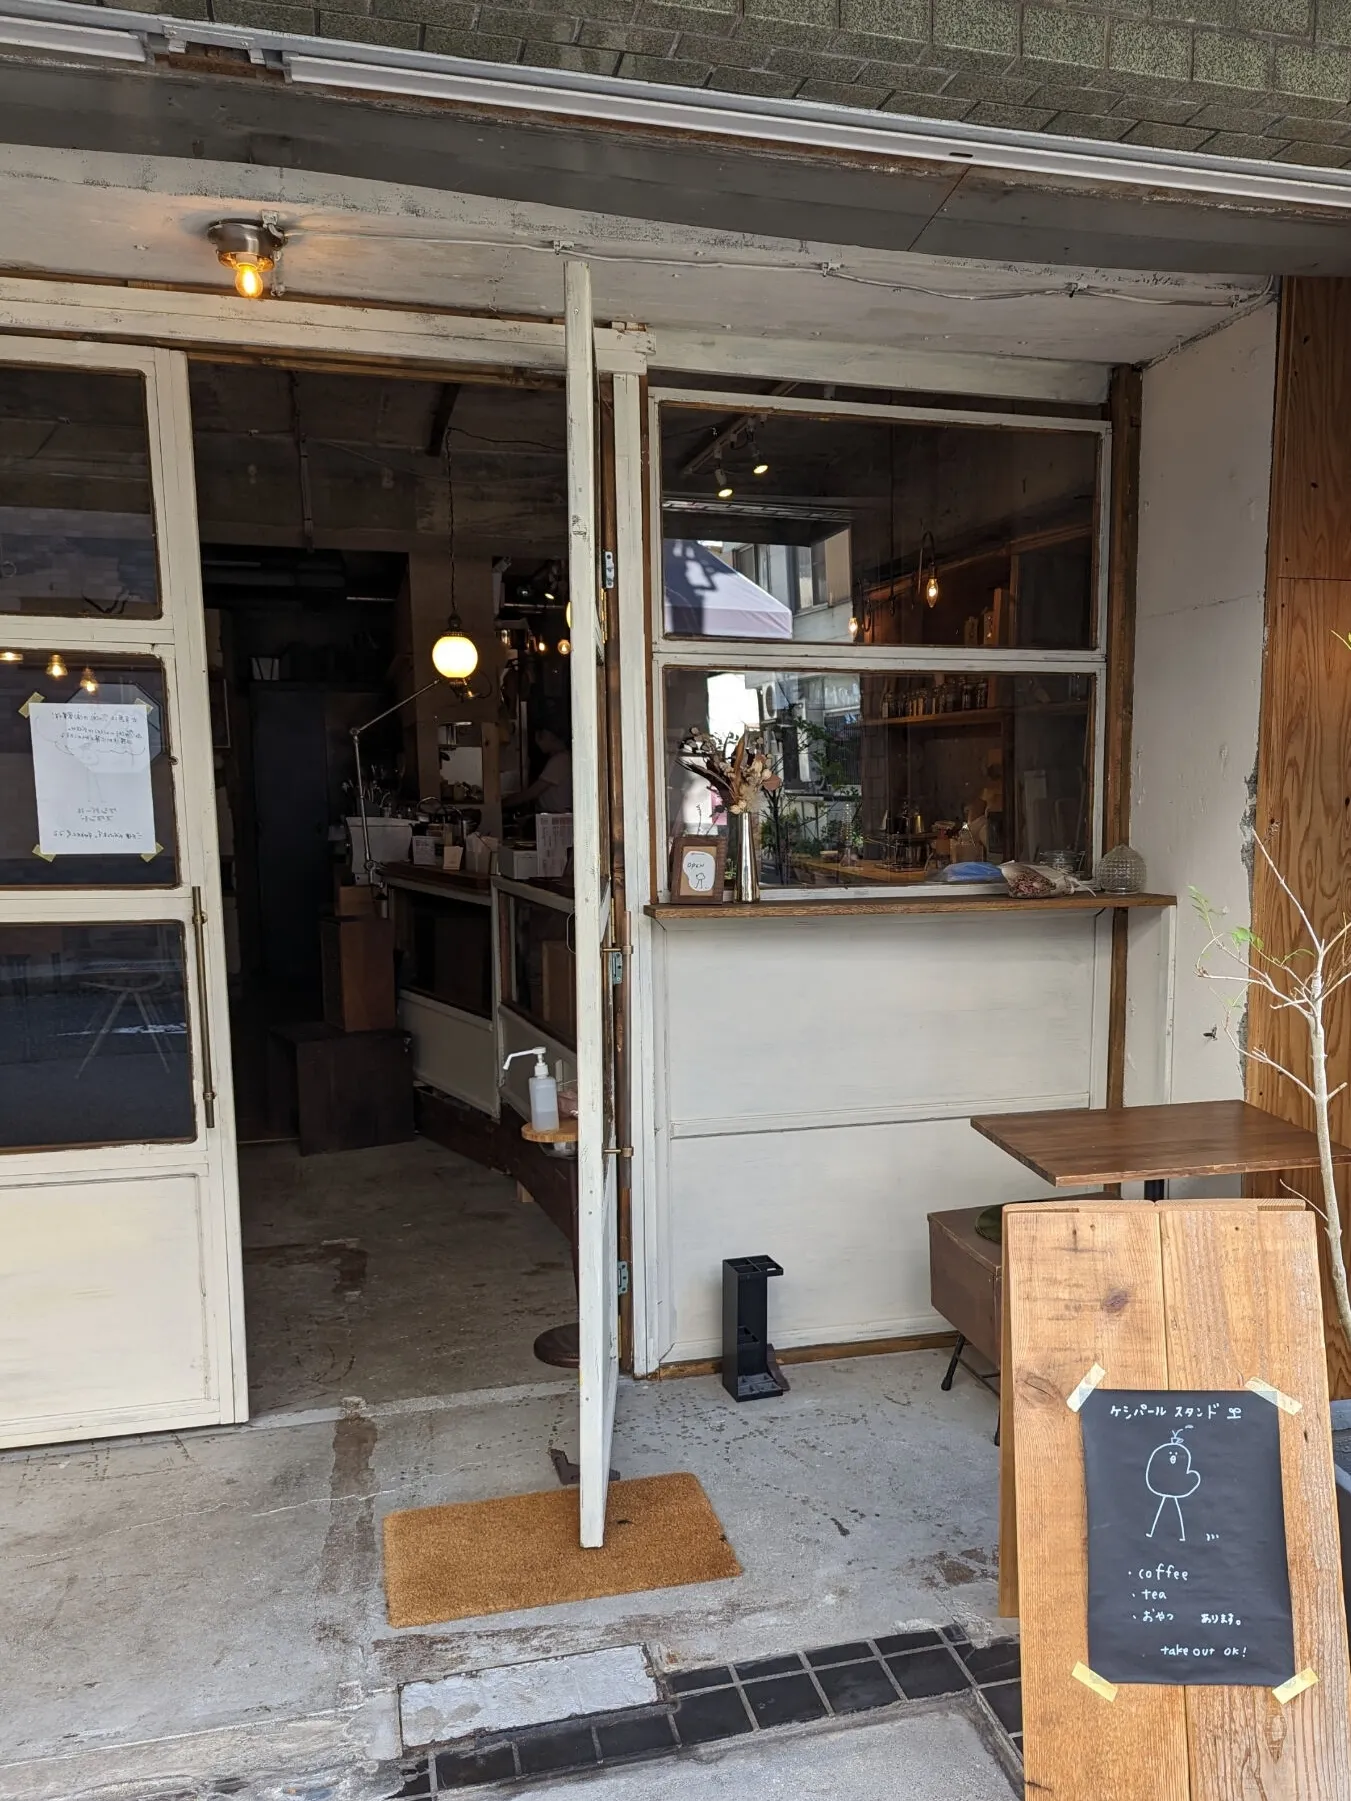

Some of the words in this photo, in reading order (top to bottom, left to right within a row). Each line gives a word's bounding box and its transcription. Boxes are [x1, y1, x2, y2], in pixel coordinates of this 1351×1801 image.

[1110, 1403, 1167, 1420] ケシパール
[1174, 1402, 1220, 1420] スタンド
[1138, 1562, 1189, 1581] coffee
[1141, 1588, 1168, 1601] tea
[1160, 1643, 1189, 1656] take
[1192, 1647, 1216, 1657] out
